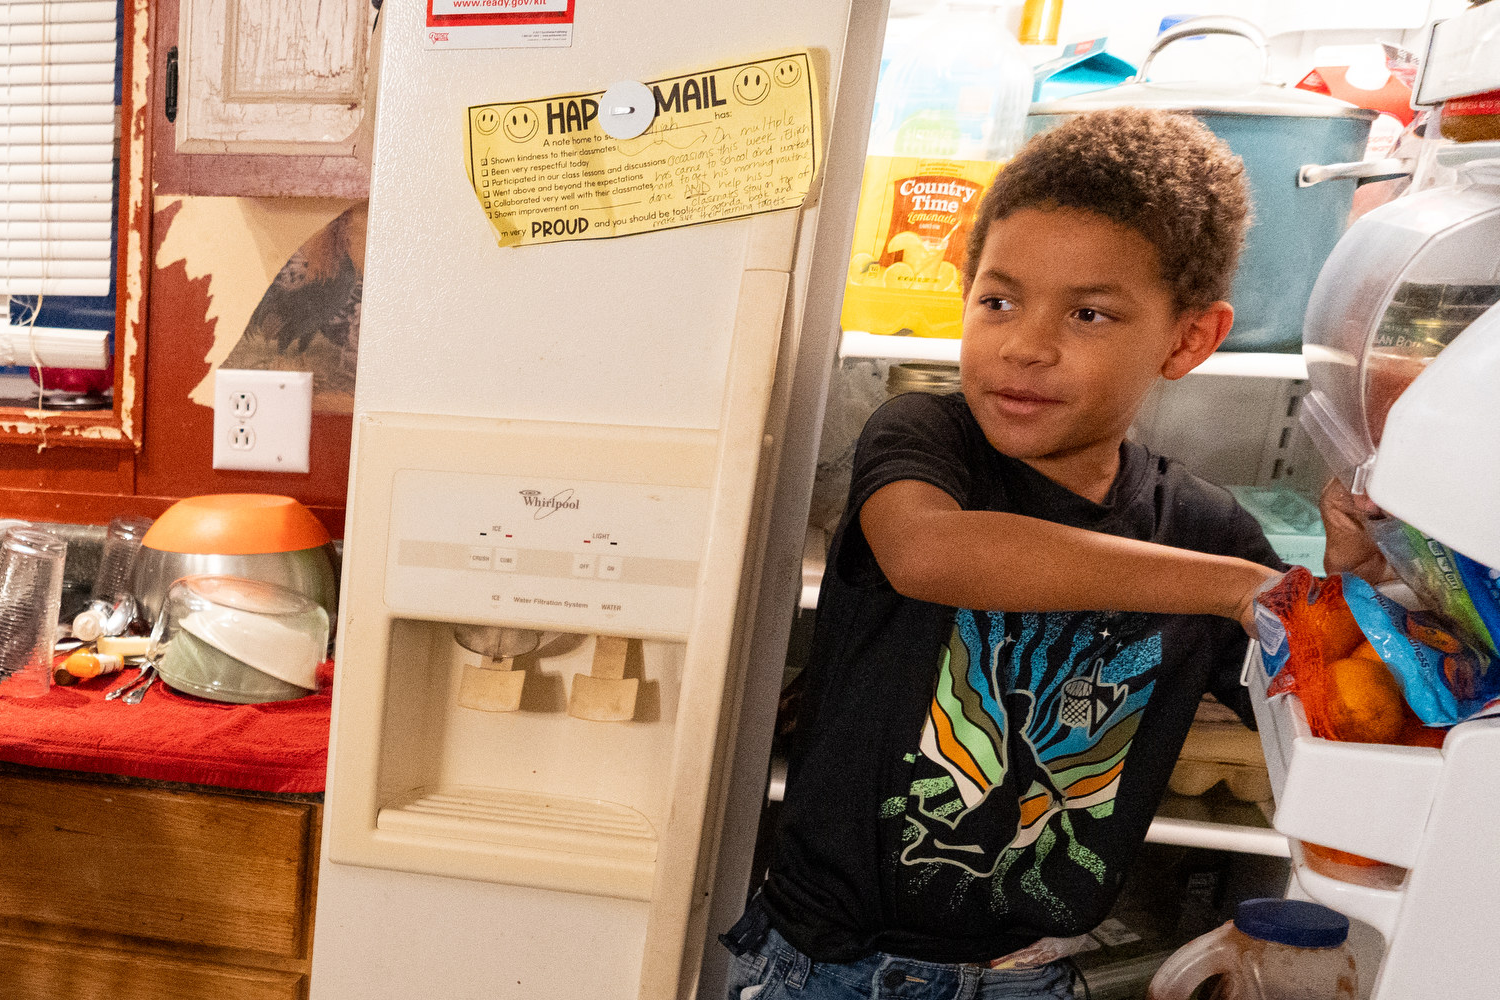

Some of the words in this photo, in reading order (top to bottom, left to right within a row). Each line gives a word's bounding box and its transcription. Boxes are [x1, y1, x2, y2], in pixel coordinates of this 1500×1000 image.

[453, 0, 547, 8] www.ready.gov/kit
[546, 98, 601, 135] HAP
[653, 75, 727, 117] MAIL
[543, 139, 550, 147] A
[552, 137, 570, 147] note
[571, 135, 592, 145] home
[714, 111, 732, 120] has:
[740, 110, 795, 137] multiple
[490, 157, 515, 165] Shown
[517, 151, 549, 162] kindness
[560, 148, 577, 158] their
[579, 145, 616, 157] classmates
[717, 143, 738, 156] this
[491, 168, 510, 176] Been
[511, 166, 529, 175] very
[530, 161, 568, 172] respectful
[569, 160, 589, 169] today
[492, 175, 537, 187] Participated
[562, 171, 580, 179] class
[582, 168, 605, 177] lessons
[607, 165, 622, 173] and
[624, 158, 666, 171] discussions
[492, 189, 511, 198] Went
[512, 186, 536, 195] above
[538, 184, 552, 192] and
[554, 182, 582, 193] beyond
[584, 180, 596, 188] the
[596, 173, 643, 187] expectations
[493, 196, 540, 208] Collaborated
[542, 195, 559, 205] very
[560, 193, 575, 201] well
[577, 191, 593, 200] with
[595, 189, 610, 198] their
[612, 182, 654, 195] classmates
[900, 179, 977, 203] Country
[494, 210, 516, 220] Shown
[518, 204, 567, 216] improvement
[569, 204, 579, 212] on
[912, 195, 959, 213] Time
[510, 228, 527, 238] very
[531, 217, 589, 238] PROUD
[594, 219, 610, 228] and
[612, 218, 627, 228] you
[629, 211, 656, 224] should
[658, 210, 670, 219] be
[907, 211, 957, 225] Lemonade
[523, 496, 580, 510] Whirlpool
[513, 596, 532, 604] Water
[533, 598, 562, 607] Filtration
[564, 600, 589, 608] System
